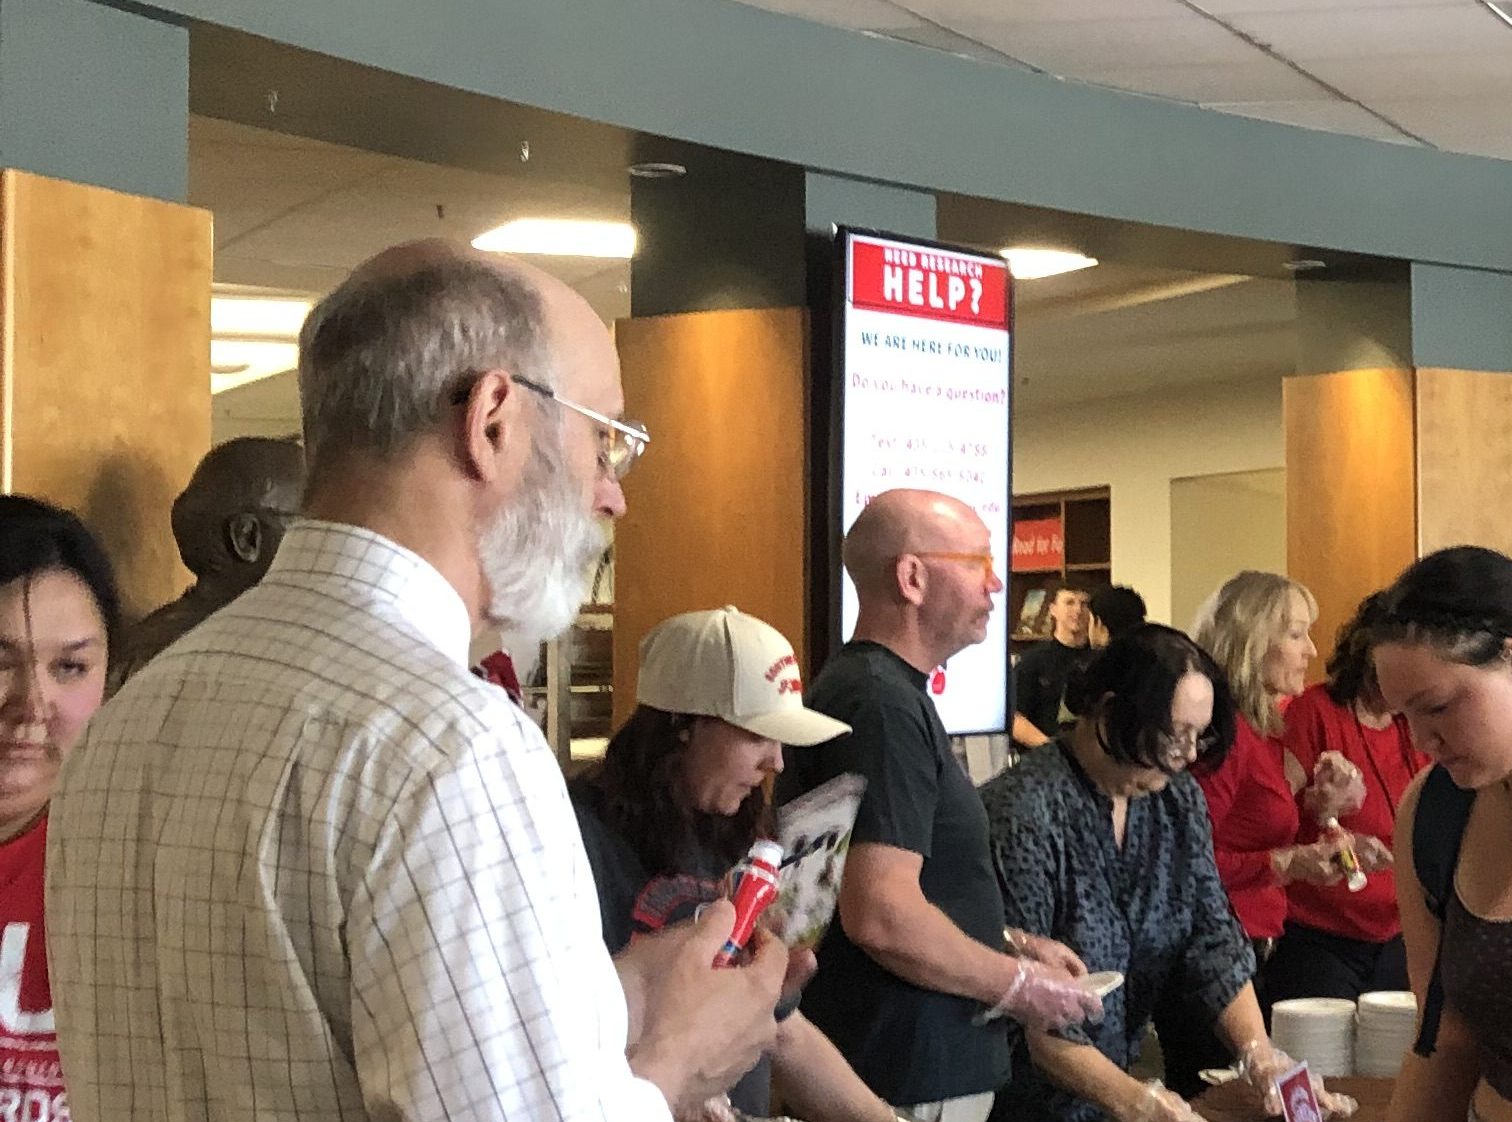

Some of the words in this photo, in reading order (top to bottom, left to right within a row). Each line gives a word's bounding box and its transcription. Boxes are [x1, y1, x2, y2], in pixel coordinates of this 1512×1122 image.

[883, 265, 983, 315] HELP?
[861, 332, 878, 347] WE
[885, 335, 906, 351] ARE
[912, 338, 942, 355] HERE
[948, 342, 971, 358] FOR
